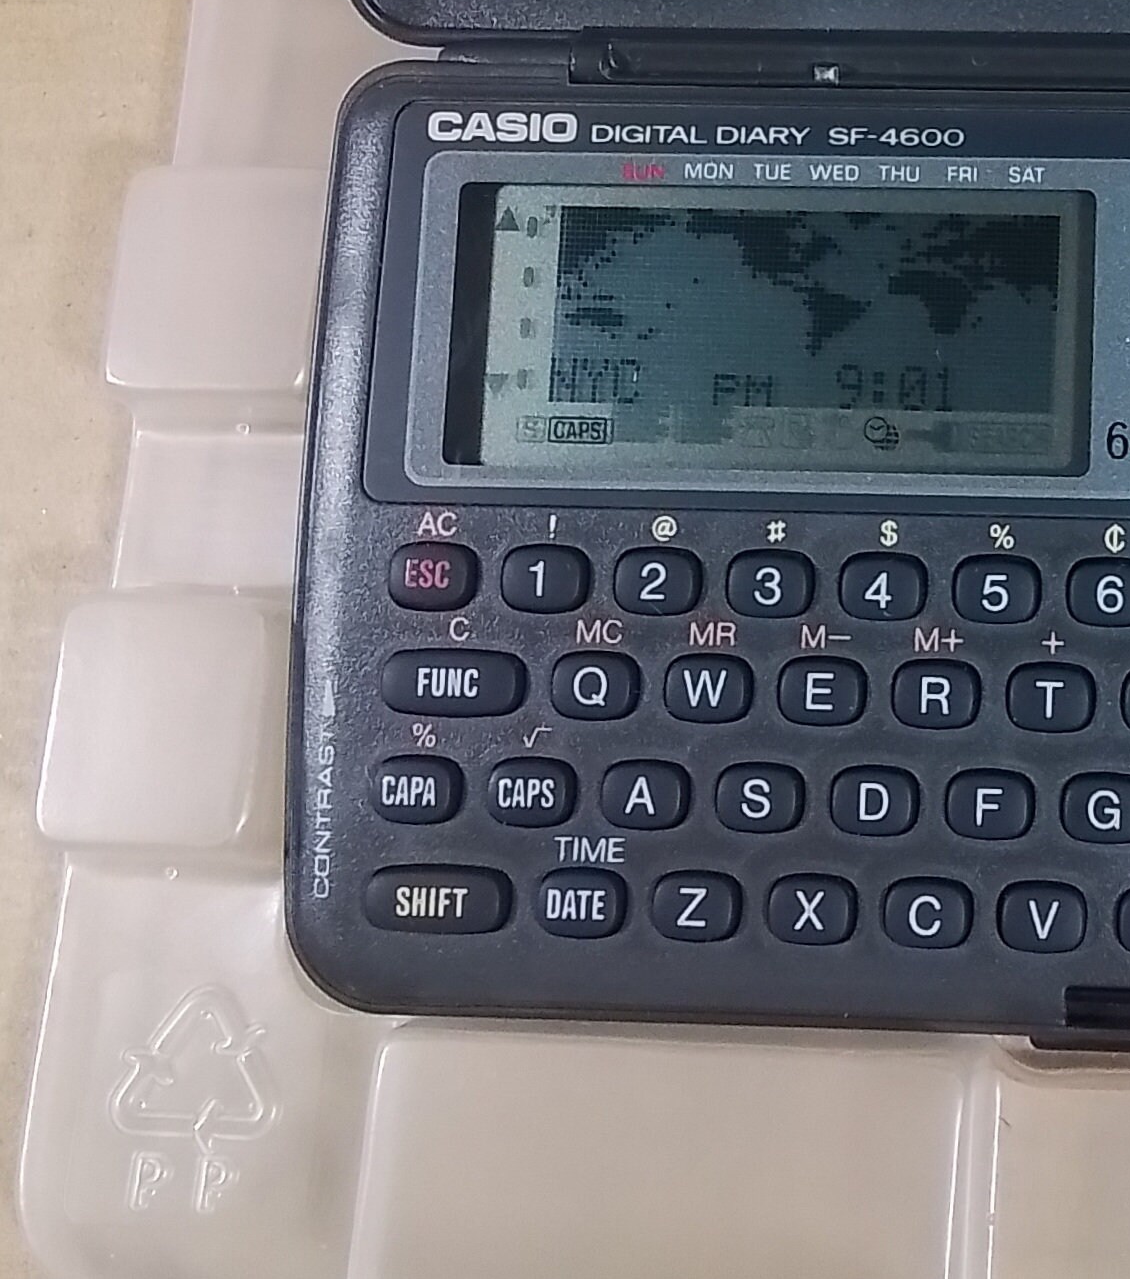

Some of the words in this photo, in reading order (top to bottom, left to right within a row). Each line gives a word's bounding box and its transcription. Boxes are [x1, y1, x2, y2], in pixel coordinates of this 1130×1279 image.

[428, 112, 577, 142] CASIO
[592, 125, 707, 143] DIGITAL
[717, 127, 809, 144] DIARY
[829, 128, 964, 146] SF-4600
[623, 162, 664, 180] SUN
[684, 162, 734, 180] MON
[754, 163, 792, 181] TUE
[810, 164, 860, 182] WED
[878, 164, 921, 182] THU
[947, 166, 978, 182] FRI
[1008, 166, 1046, 184] SAT
[713, 373, 773, 408] PM
[835, 363, 952, 412] 9:01
[554, 421, 602, 440] CAPS
[416, 512, 457, 535] AC
[405, 559, 450, 589] ESC
[575, 620, 623, 644] MC
[688, 623, 735, 646] MR
[913, 627, 964, 652] M+
[416, 668, 479, 697] FUNC
[381, 776, 436, 806] CAPA
[498, 778, 556, 808] CAPS
[313, 722, 336, 899] CONTRAST
[555, 837, 626, 862] TIME
[395, 887, 468, 917] SHIFT
[546, 889, 606, 920] DATE
